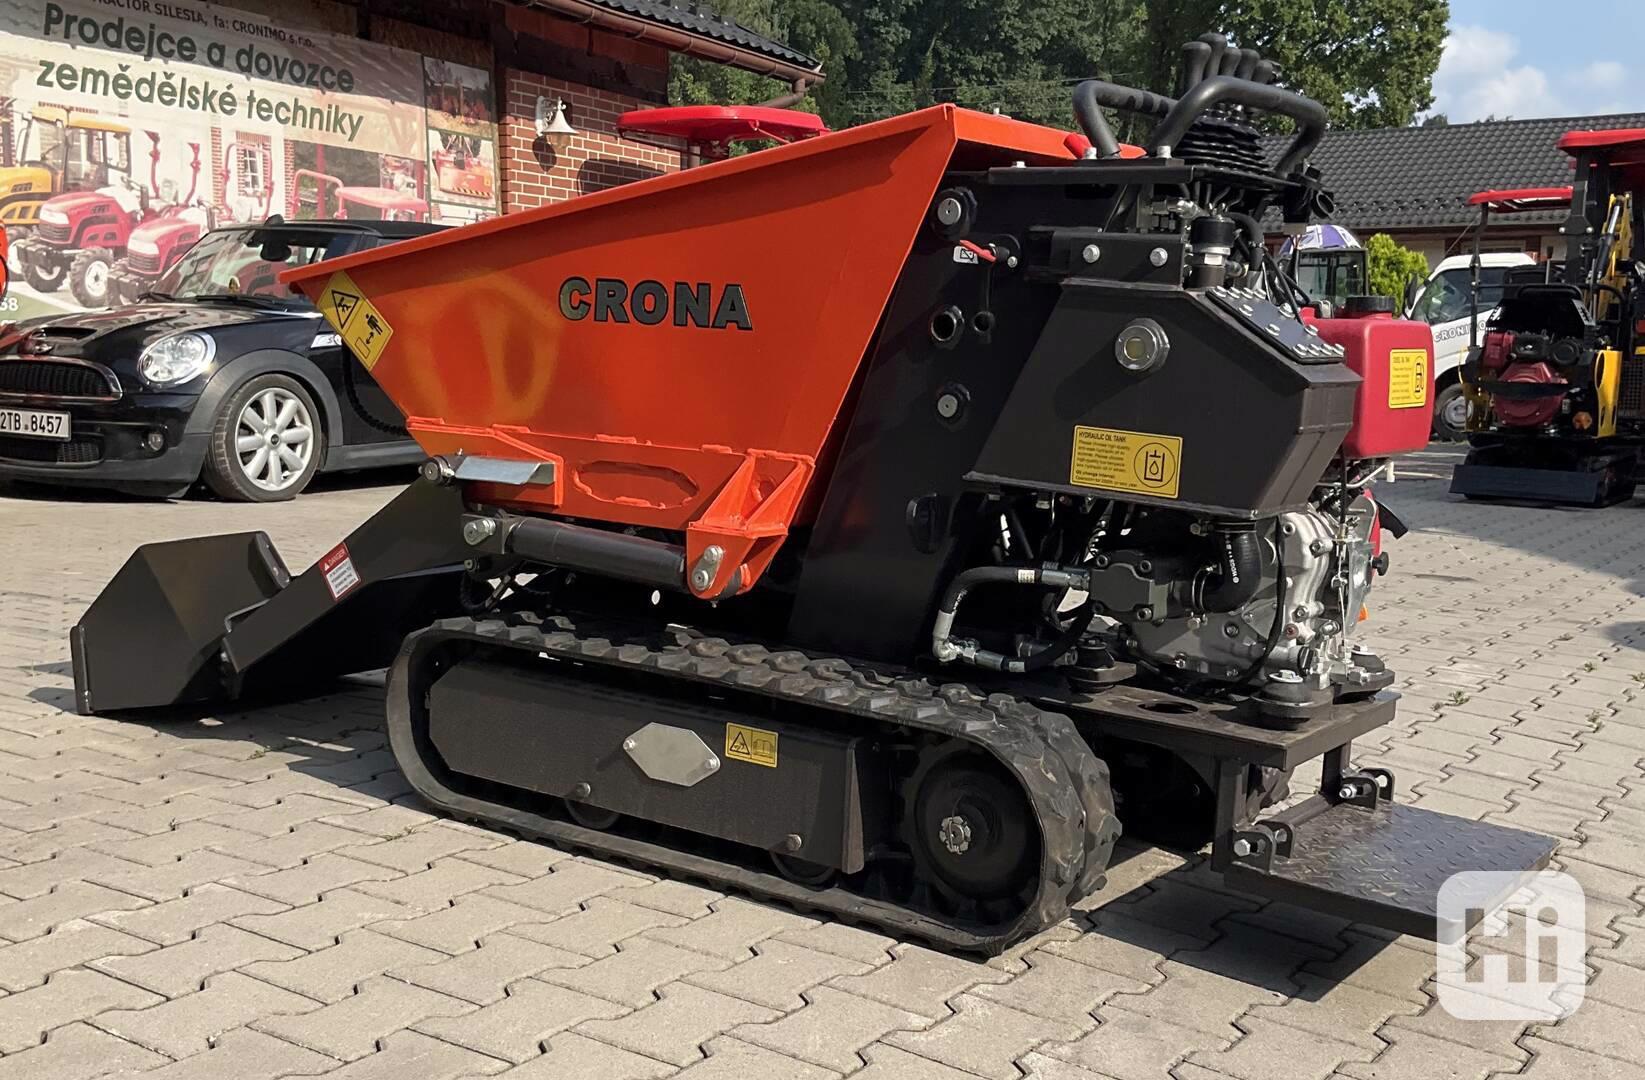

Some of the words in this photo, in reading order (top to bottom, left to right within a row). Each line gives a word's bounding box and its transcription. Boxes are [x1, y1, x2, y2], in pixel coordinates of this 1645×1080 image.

[97, 0, 151, 13] ACTOR
[154, 3, 208, 27] SILESIA,
[213, 15, 229, 29] fa:
[232, 19, 286, 42] CRONIMO
[43, 2, 197, 62] Prodejce
[206, 40, 226, 68] a
[235, 44, 355, 92] dovozce
[36, 59, 238, 116] zemědělské
[247, 89, 364, 142] techniky
[558, 276, 753, 331] CRONA
[1434, 320, 1486, 342] CRONIO
[0, 411, 21, 431] 2TB
[30, 414, 63, 434] 8457
[1079, 431, 1105, 440] HYDRAULIC
